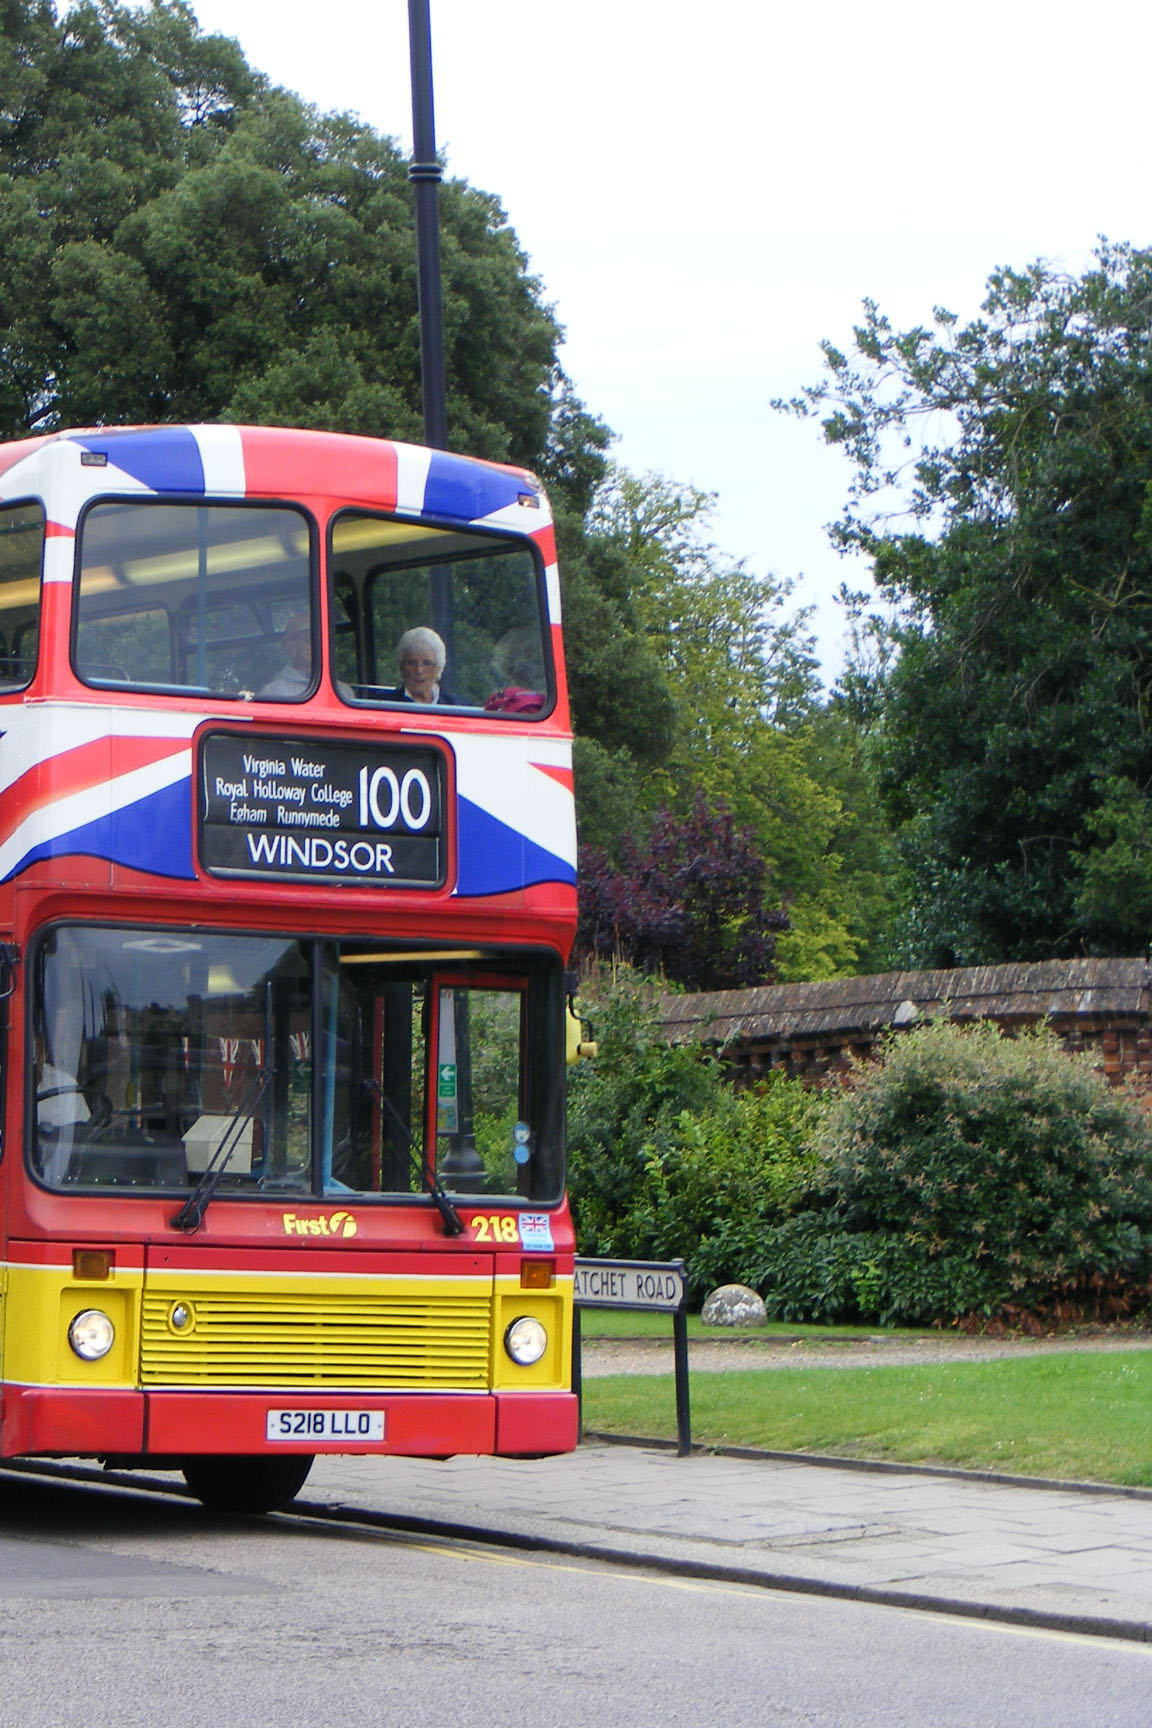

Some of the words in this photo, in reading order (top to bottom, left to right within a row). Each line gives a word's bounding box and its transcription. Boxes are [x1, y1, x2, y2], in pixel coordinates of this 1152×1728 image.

[243, 754, 286, 778] Virginia
[290, 757, 326, 778] Water
[216, 777, 248, 802] Royal
[254, 779, 306, 806] Holloway
[311, 784, 353, 808] College
[359, 765, 431, 830] 100
[230, 803, 267, 825] Egham
[277, 806, 340, 828] Runnymede
[247, 833, 394, 873] WINDSOR
[282, 1213, 330, 1236] First
[471, 1216, 519, 1243] 218
[636, 1274, 676, 1299] ROAD
[280, 1412, 325, 1434] S218
[331, 1412, 370, 1434] LLO
